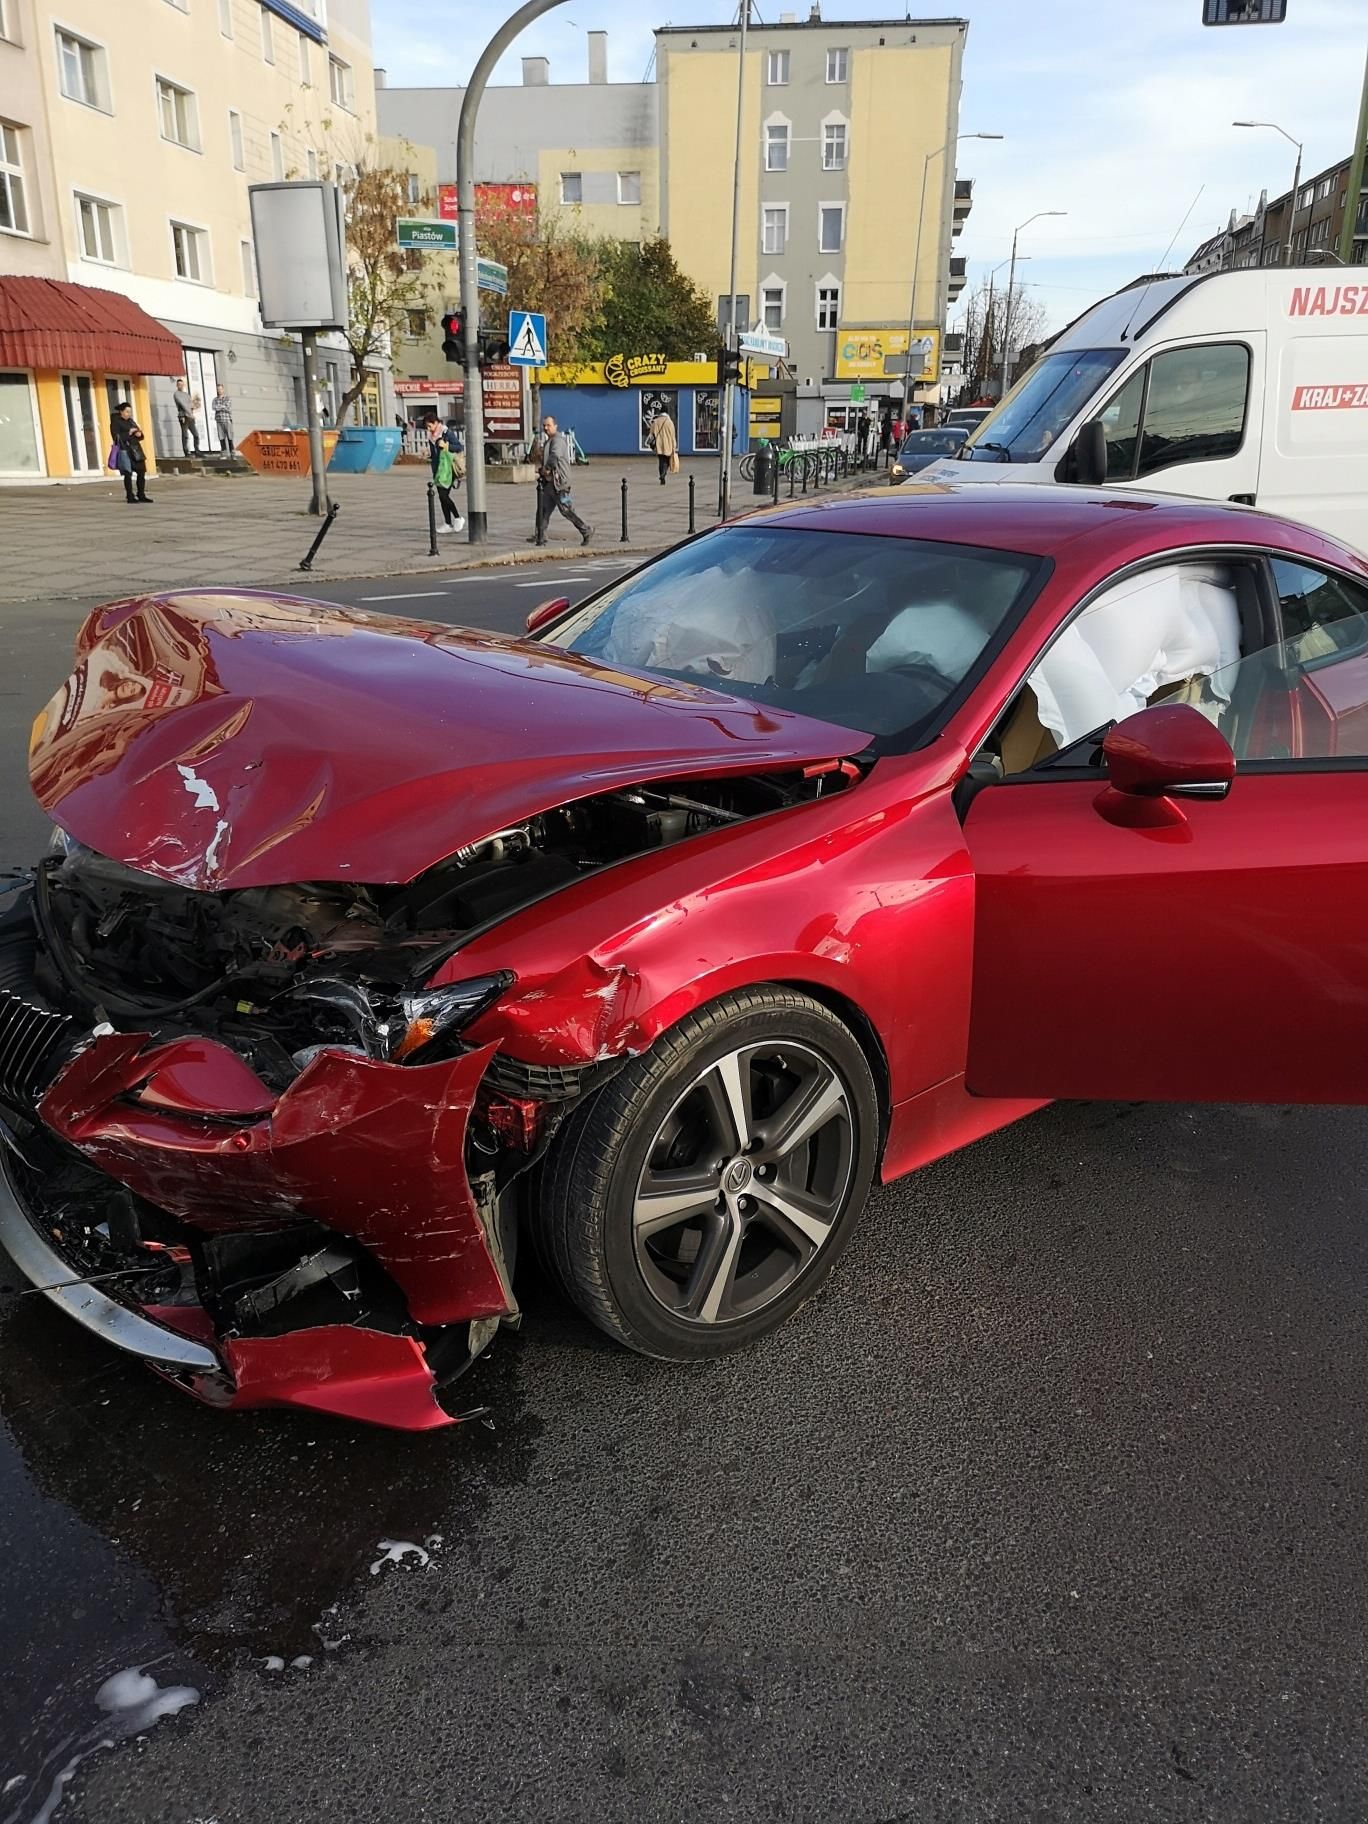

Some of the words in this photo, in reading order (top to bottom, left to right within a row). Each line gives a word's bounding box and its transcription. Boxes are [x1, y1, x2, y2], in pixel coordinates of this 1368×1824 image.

[412, 231, 444, 241] Piastów
[1289, 286, 1368, 316] NAJSZ
[627, 353, 666, 370] CRAZY
[630, 364, 666, 377] CROISSANT
[261, 446, 299, 457] GRUZ-MIX
